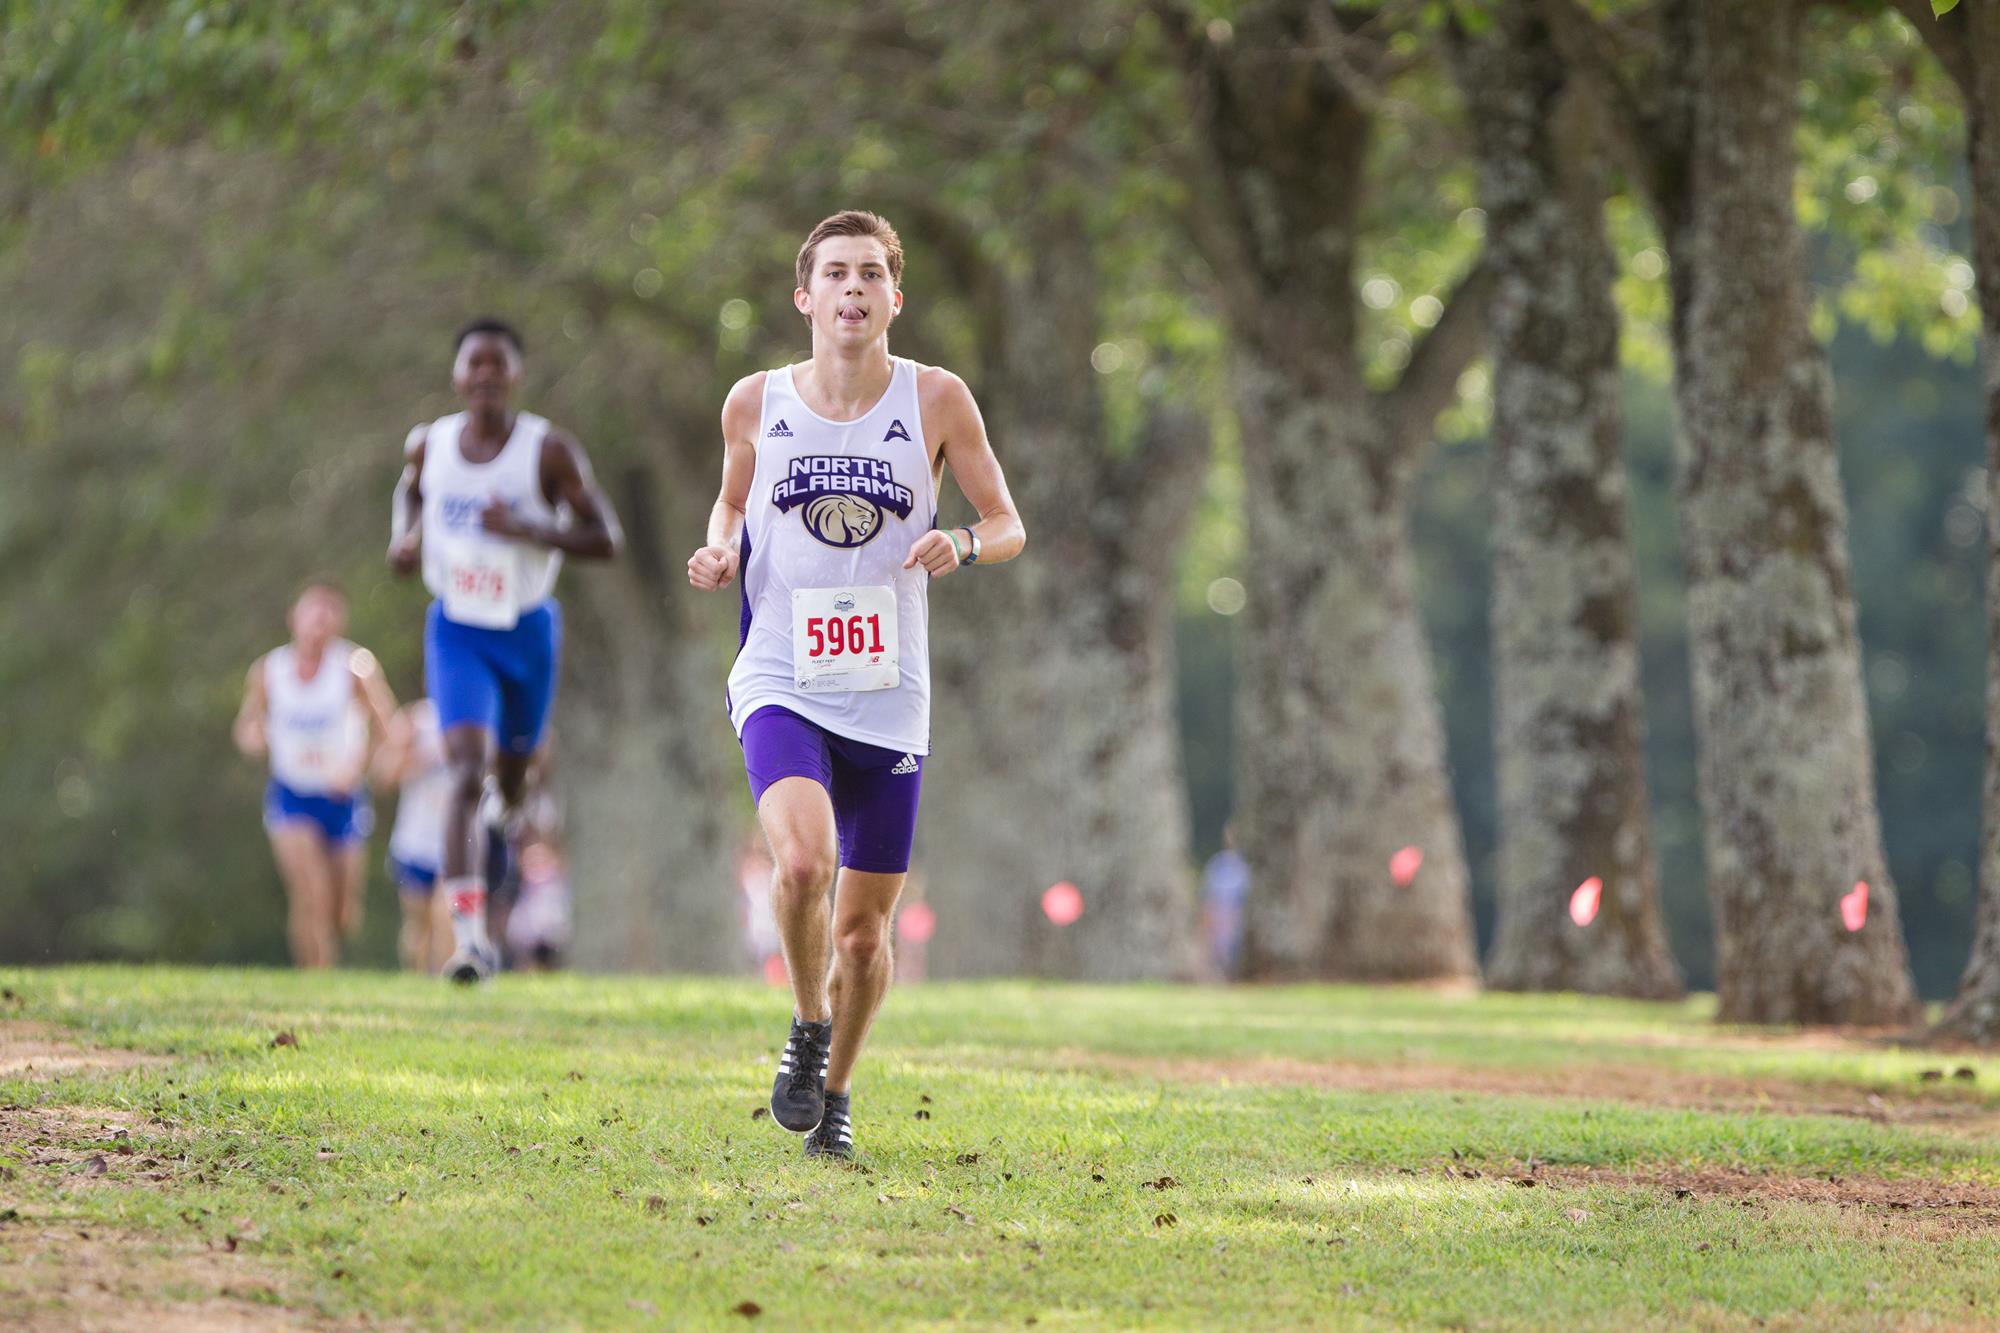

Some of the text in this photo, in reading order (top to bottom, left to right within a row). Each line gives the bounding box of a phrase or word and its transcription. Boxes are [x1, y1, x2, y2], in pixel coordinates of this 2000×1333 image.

[767, 430, 794, 438] adidas
[791, 457, 891, 480] NORTH
[773, 475, 912, 507] ALABAMA
[807, 613, 885, 657] 5961
